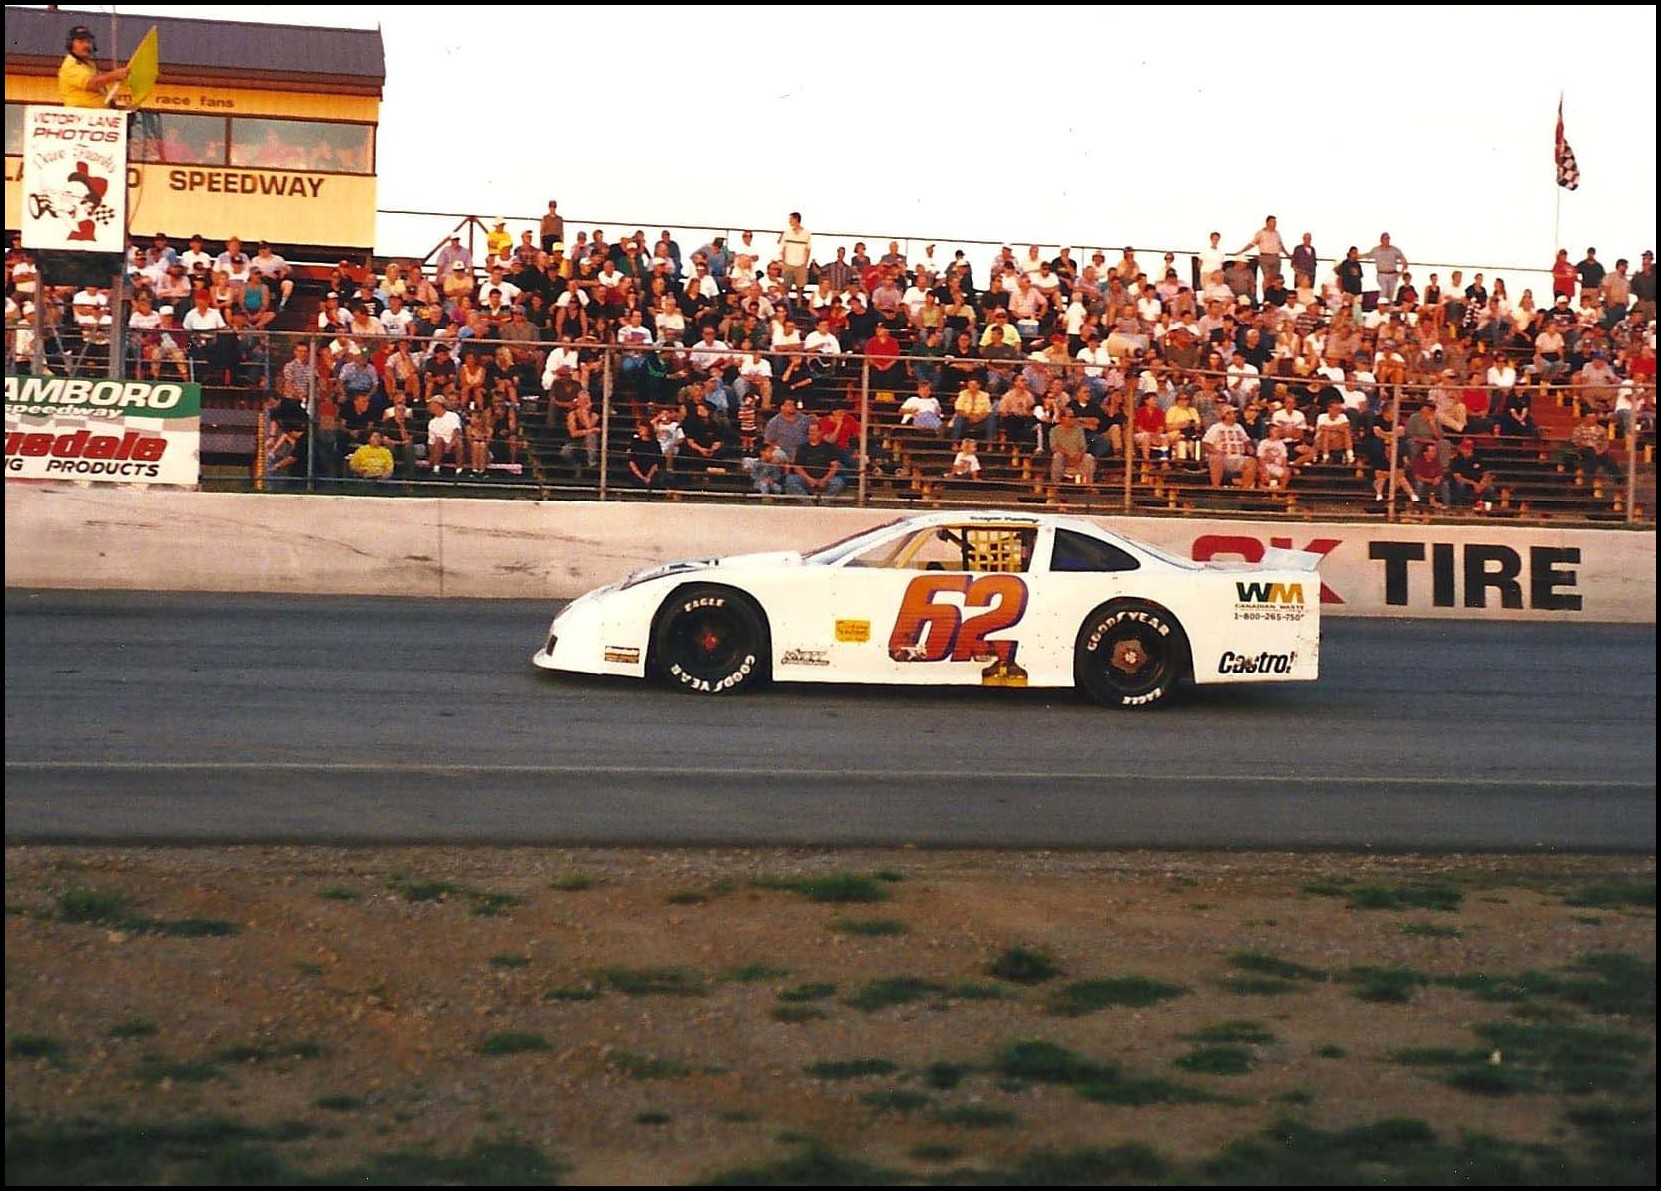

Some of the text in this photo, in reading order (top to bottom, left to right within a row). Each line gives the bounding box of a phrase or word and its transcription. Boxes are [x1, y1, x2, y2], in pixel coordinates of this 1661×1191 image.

[155, 95, 235, 108] race fans
[34, 112, 122, 128] VICTORY LANE
[33, 127, 121, 142] PHOTOS
[169, 170, 325, 198] SPEEDWAY
[46, 460, 160, 477] PRODUCTS
[1369, 541, 1584, 611] TIRE
[1235, 582, 1305, 604] WM
[684, 598, 725, 612] EAGLE
[888, 574, 1029, 662] 62
[1087, 611, 1170, 651] GOODYEAR
[670, 654, 755, 693] GOODYEAR
